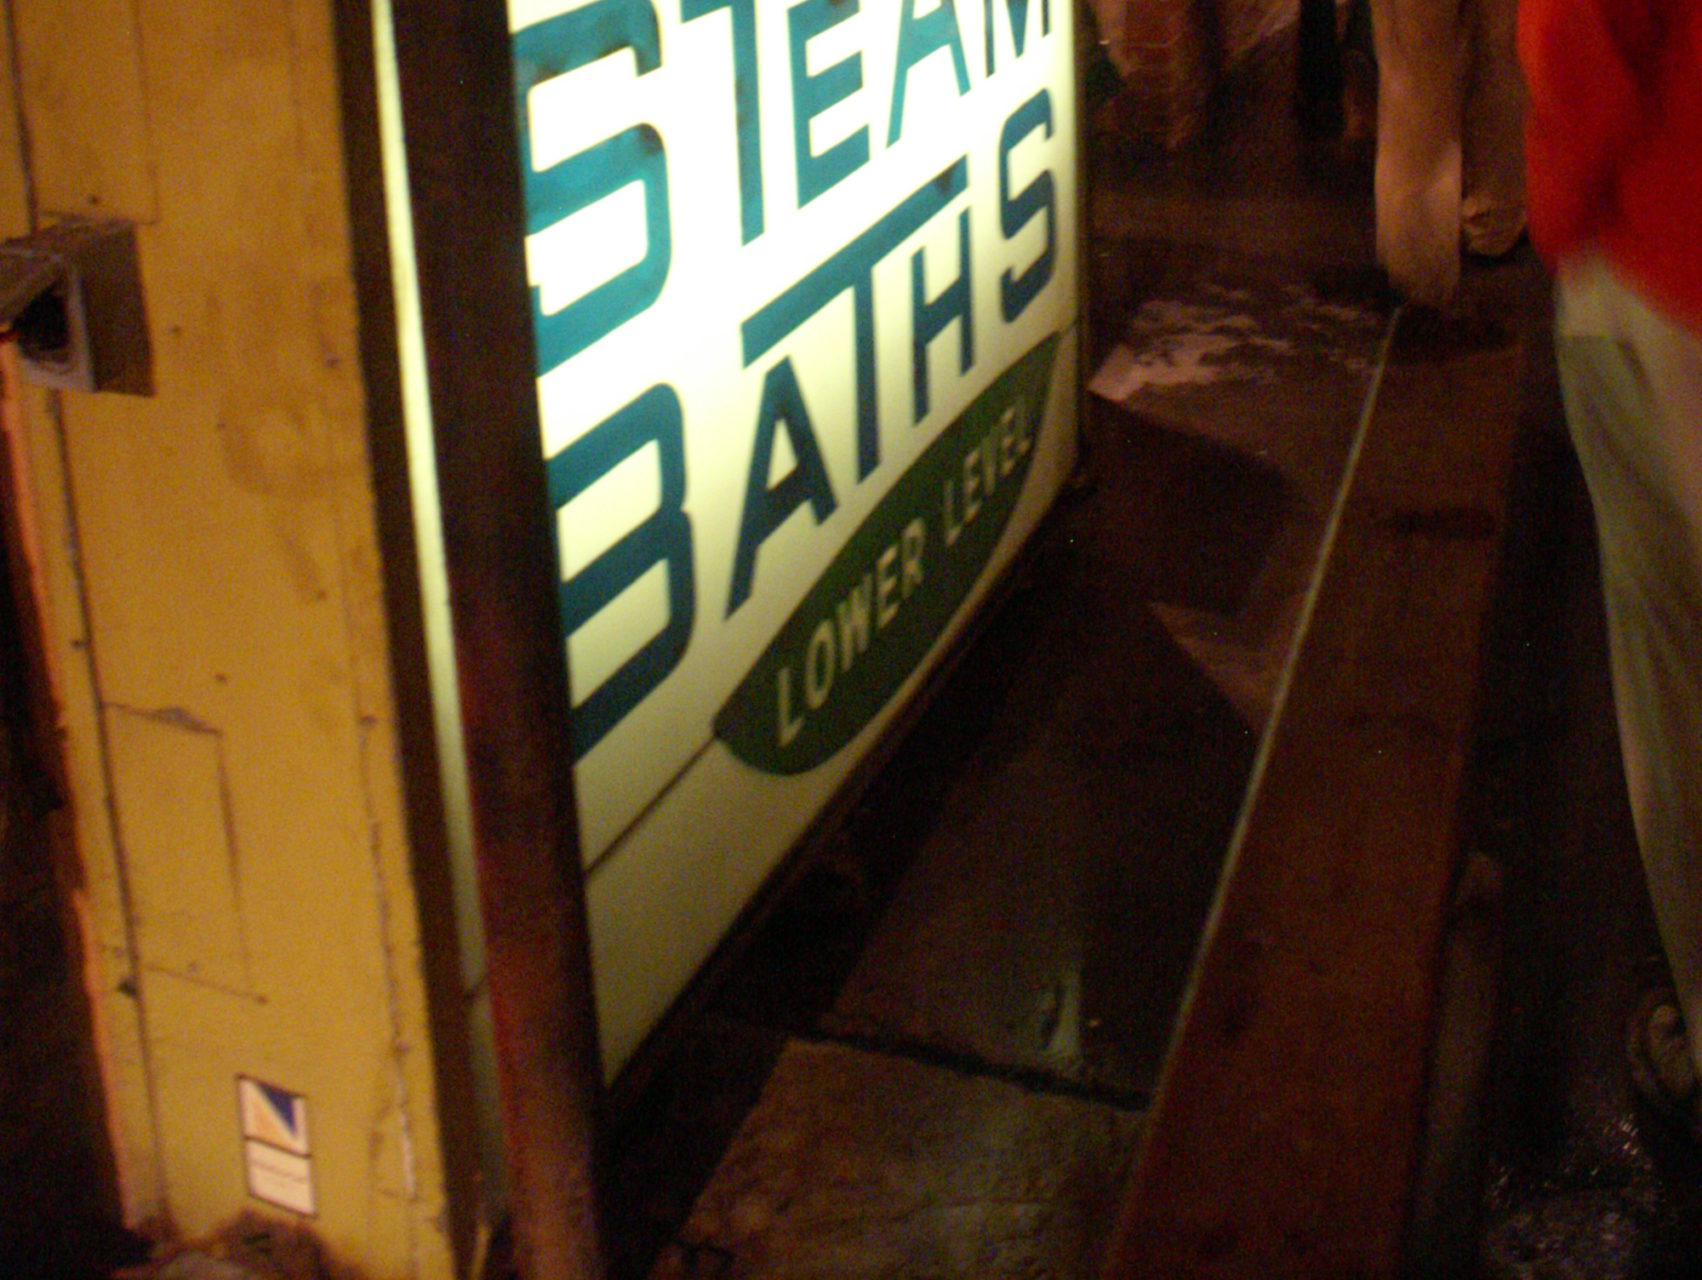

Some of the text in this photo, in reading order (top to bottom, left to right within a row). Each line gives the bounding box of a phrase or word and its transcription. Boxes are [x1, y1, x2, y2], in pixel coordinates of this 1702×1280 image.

[546, 87, 1058, 767] BATHS
[777, 396, 1032, 748] LOWER LEVEL
